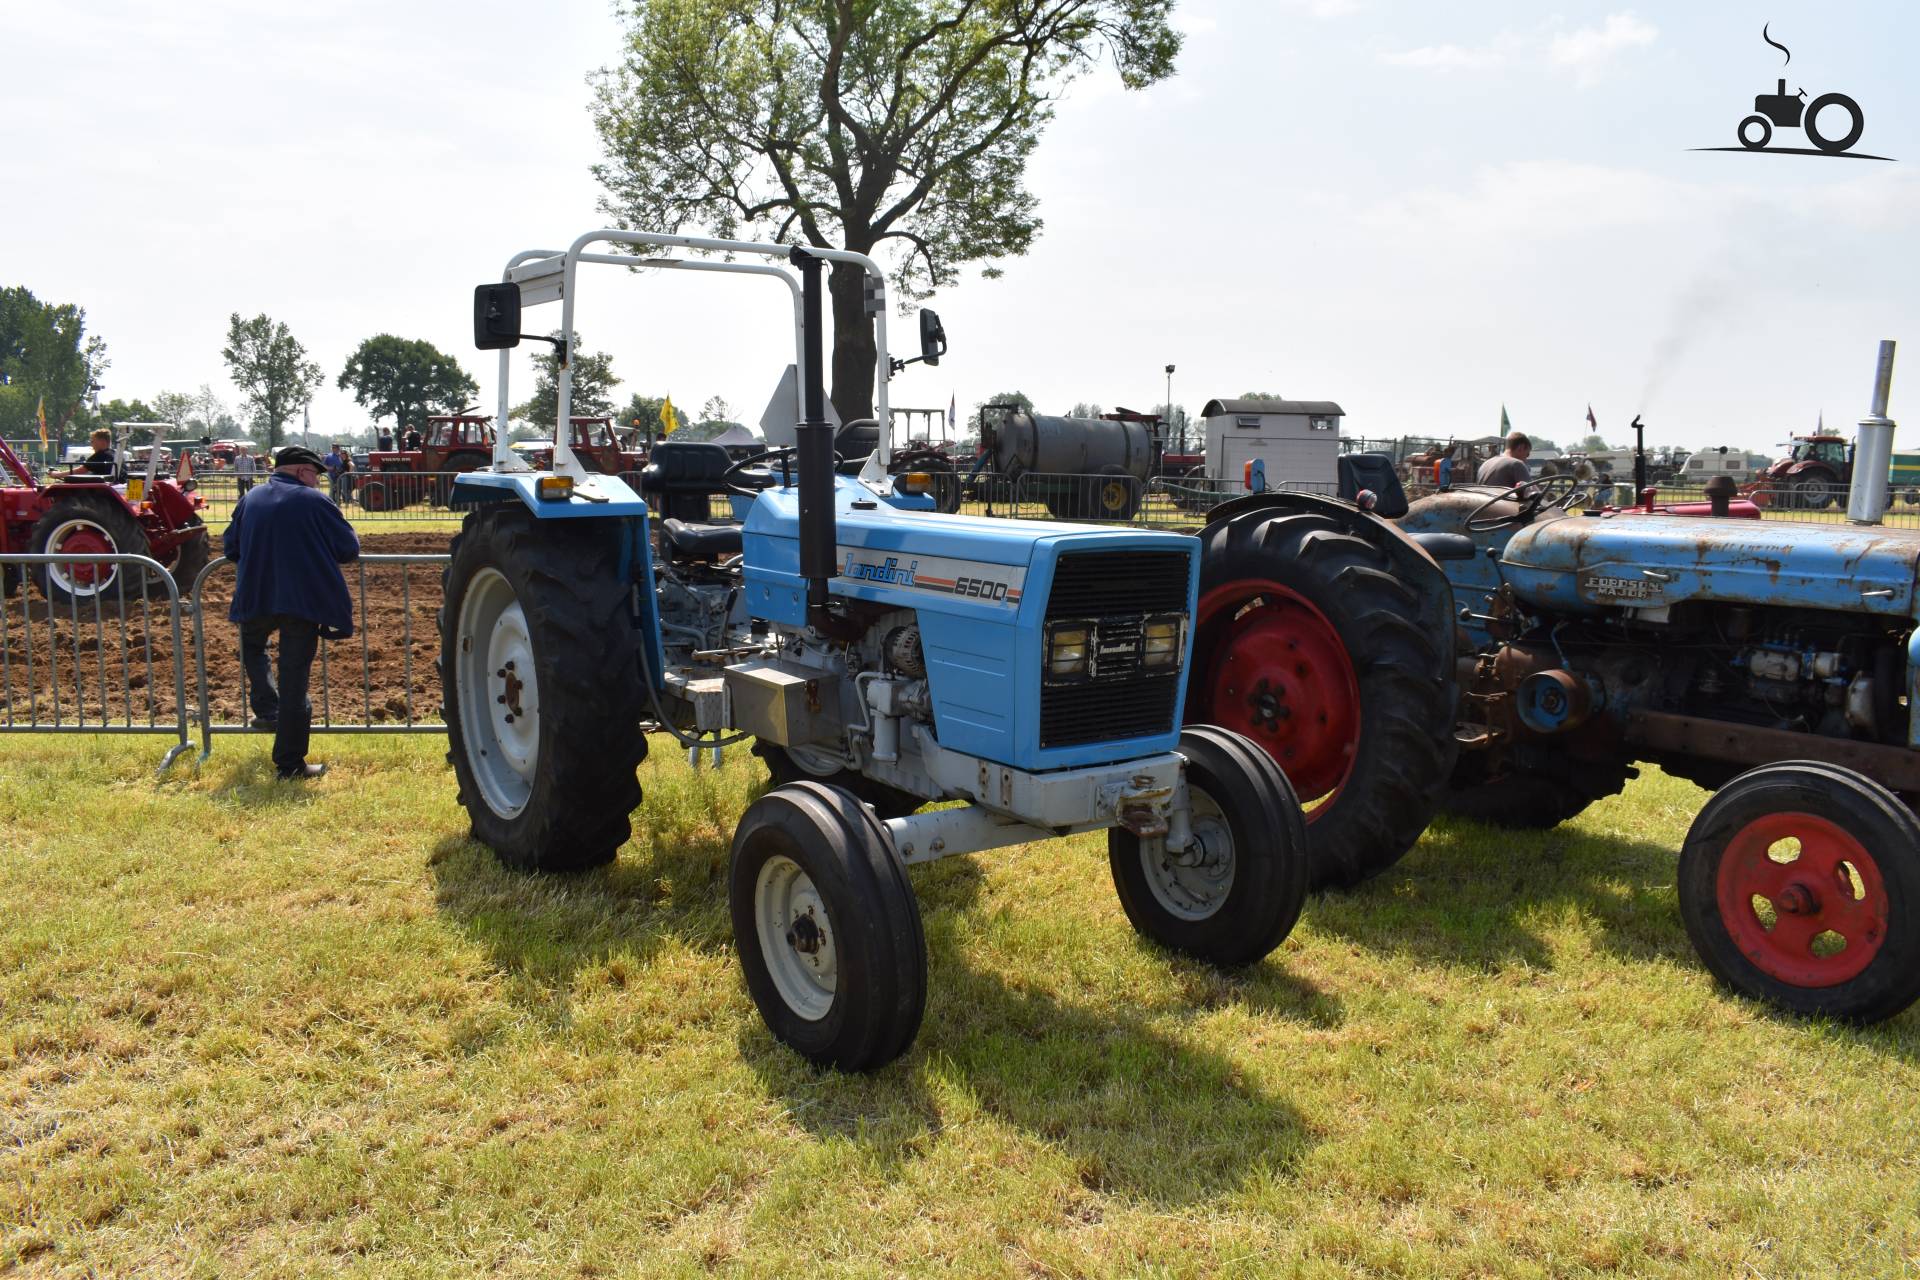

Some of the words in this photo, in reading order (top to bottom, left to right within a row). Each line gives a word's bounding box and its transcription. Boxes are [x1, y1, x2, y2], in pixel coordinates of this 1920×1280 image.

[954, 576, 1008, 601] 6500
[1585, 577, 1663, 593] FORDSON
[1598, 587, 1648, 599] MAJOR
